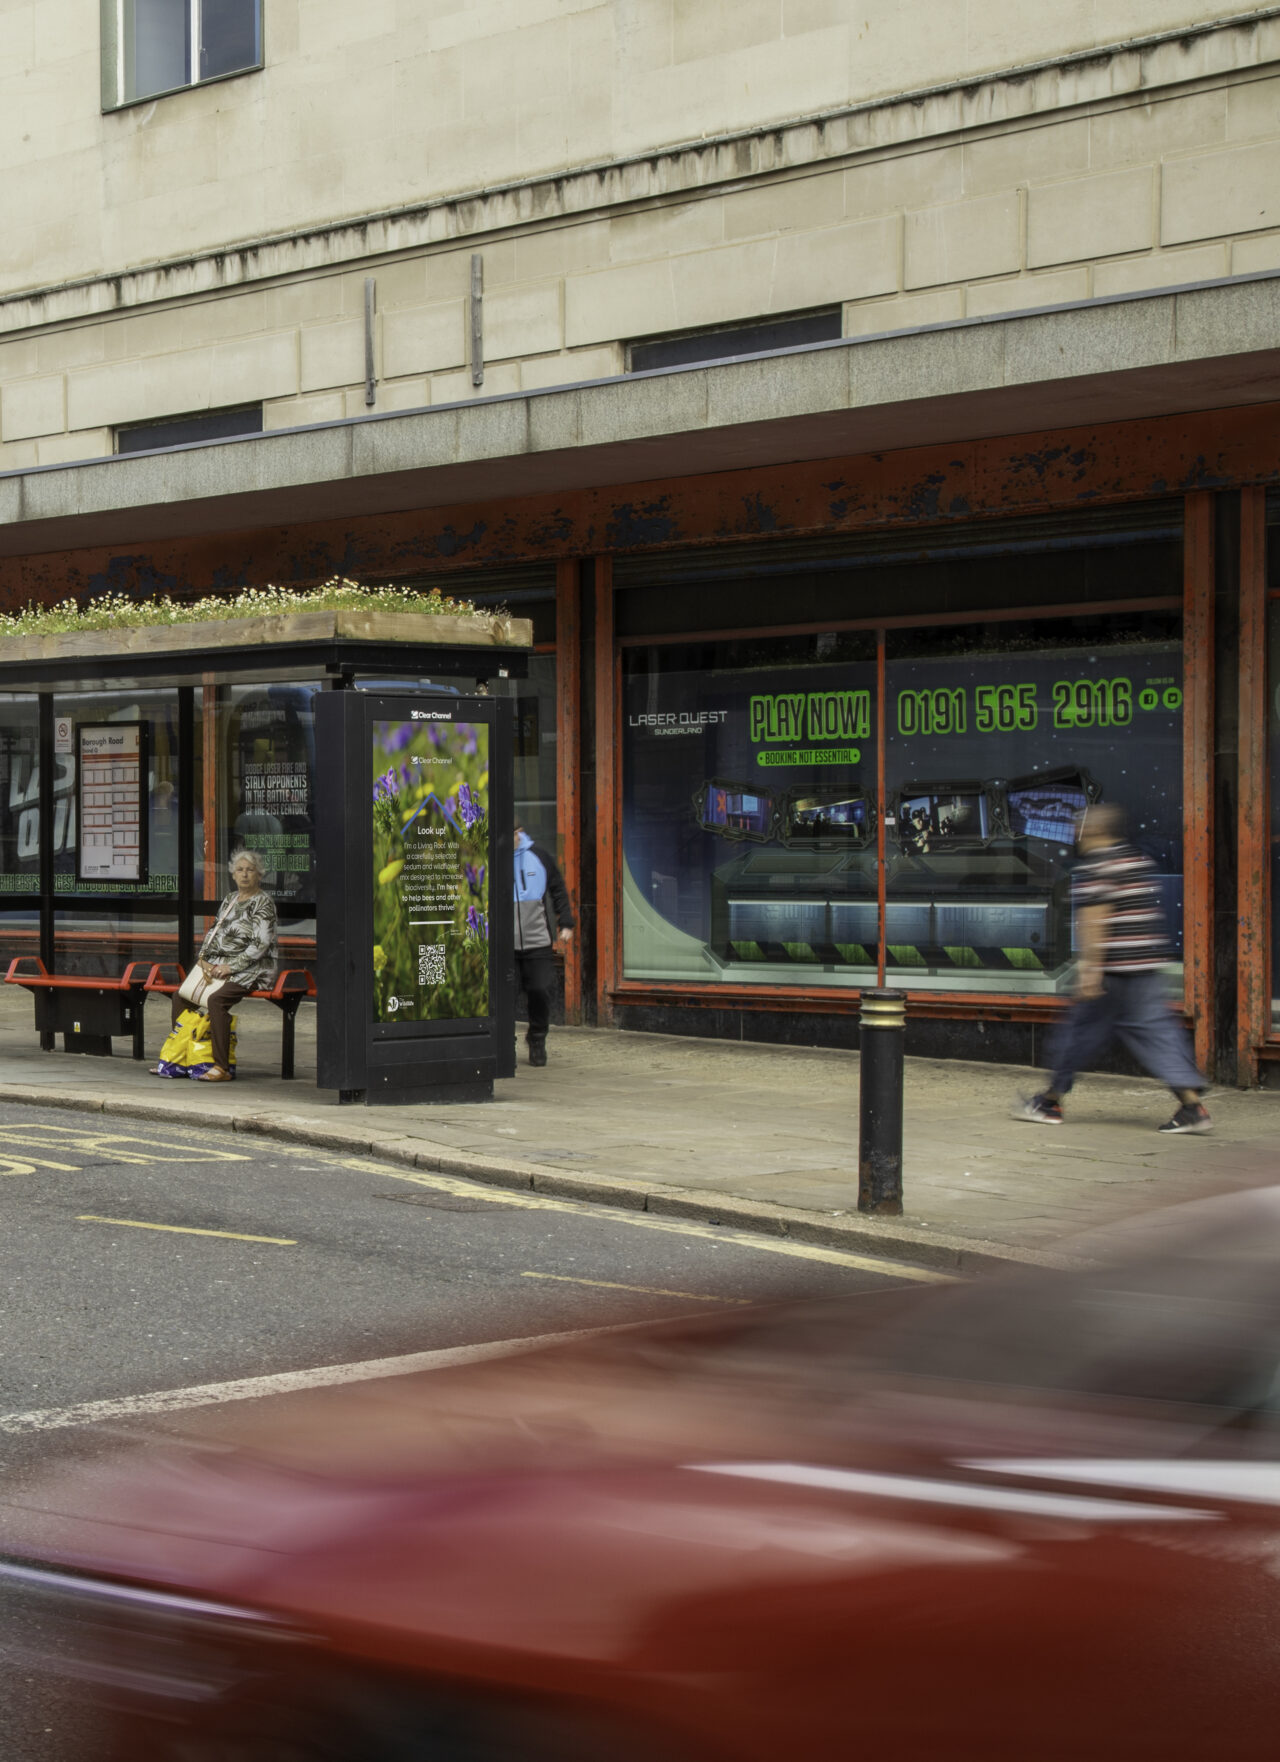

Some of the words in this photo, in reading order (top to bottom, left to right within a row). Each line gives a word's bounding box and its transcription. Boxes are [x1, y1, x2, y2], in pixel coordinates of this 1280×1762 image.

[899, 690, 966, 734] 0191
[977, 685, 1036, 731] 565
[1054, 679, 1131, 728] 2916
[629, 713, 676, 726] LASER
[679, 711, 728, 725] QUEST
[752, 696, 804, 740] PLAY
[809, 692, 869, 738] NOW!
[654, 727, 703, 736] SUNDERLAND
[82, 737, 107, 746] Borough
[108, 736, 123, 744] Road
[765, 752, 797, 764] BOOKING
[799, 752, 813, 764] NOT
[815, 750, 852, 763] ESSENTIAL
[245, 775, 266, 789] STALK
[266, 774, 308, 789] OPPONENTS
[245, 790, 252, 803] IN
[253, 790, 266, 802] THE
[266, 789, 290, 802] BATTLE
[290, 789, 308, 802] ZONE
[245, 803, 253, 816] OF
[254, 803, 265, 816] THE
[266, 803, 280, 815] 21ST
[417, 826, 434, 835] Look
[435, 826, 446, 836] up!
[417, 842, 433, 851] Living
[411, 853, 434, 861] carefully
[410, 873, 435, 882] designed
[408, 894, 421, 902] help
[408, 905, 437, 913] pollinators
